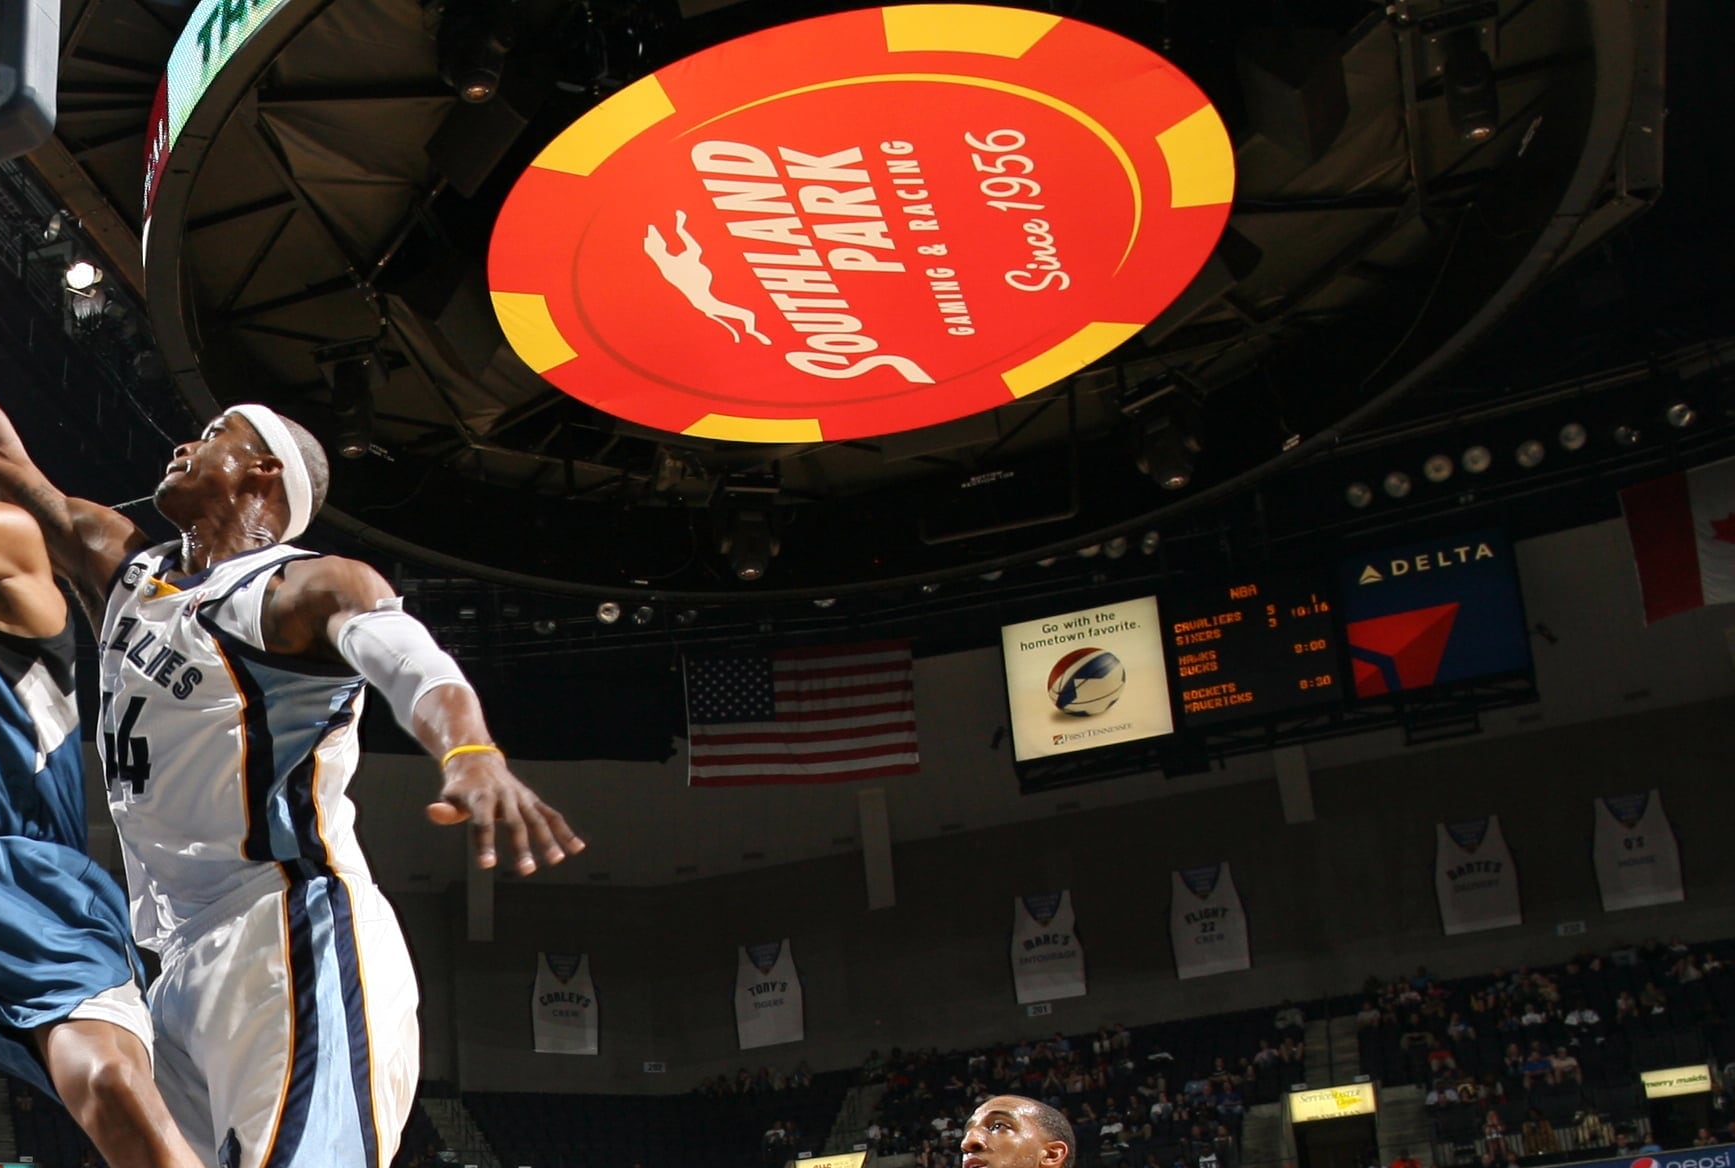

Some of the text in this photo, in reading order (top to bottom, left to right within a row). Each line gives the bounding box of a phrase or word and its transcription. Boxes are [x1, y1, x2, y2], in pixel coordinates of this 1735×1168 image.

[776, 145, 905, 273] PARK
[965, 128, 1070, 292] Since 1956
[879, 140, 975, 337] GAMING & RACING
[690, 140, 935, 384] SOUTHLAND
[1391, 543, 1494, 577] DELTA
[1230, 584, 1258, 599] NBA
[1042, 611, 1115, 634] Go with the
[1174, 612, 1243, 633] CAVALIERS
[1020, 620, 1141, 651] hometown favorite.
[1176, 629, 1221, 645] SIXERS
[103, 617, 203, 700] ZLIES
[1179, 650, 1216, 666] HAWKS
[1180, 662, 1218, 676] BUCKS
[1183, 682, 1237, 700] ROCKETS
[1185, 692, 1253, 713] MAVERICKS
[1184, 907, 1228, 924] FLIGHT
[748, 981, 788, 997] TONY'S
